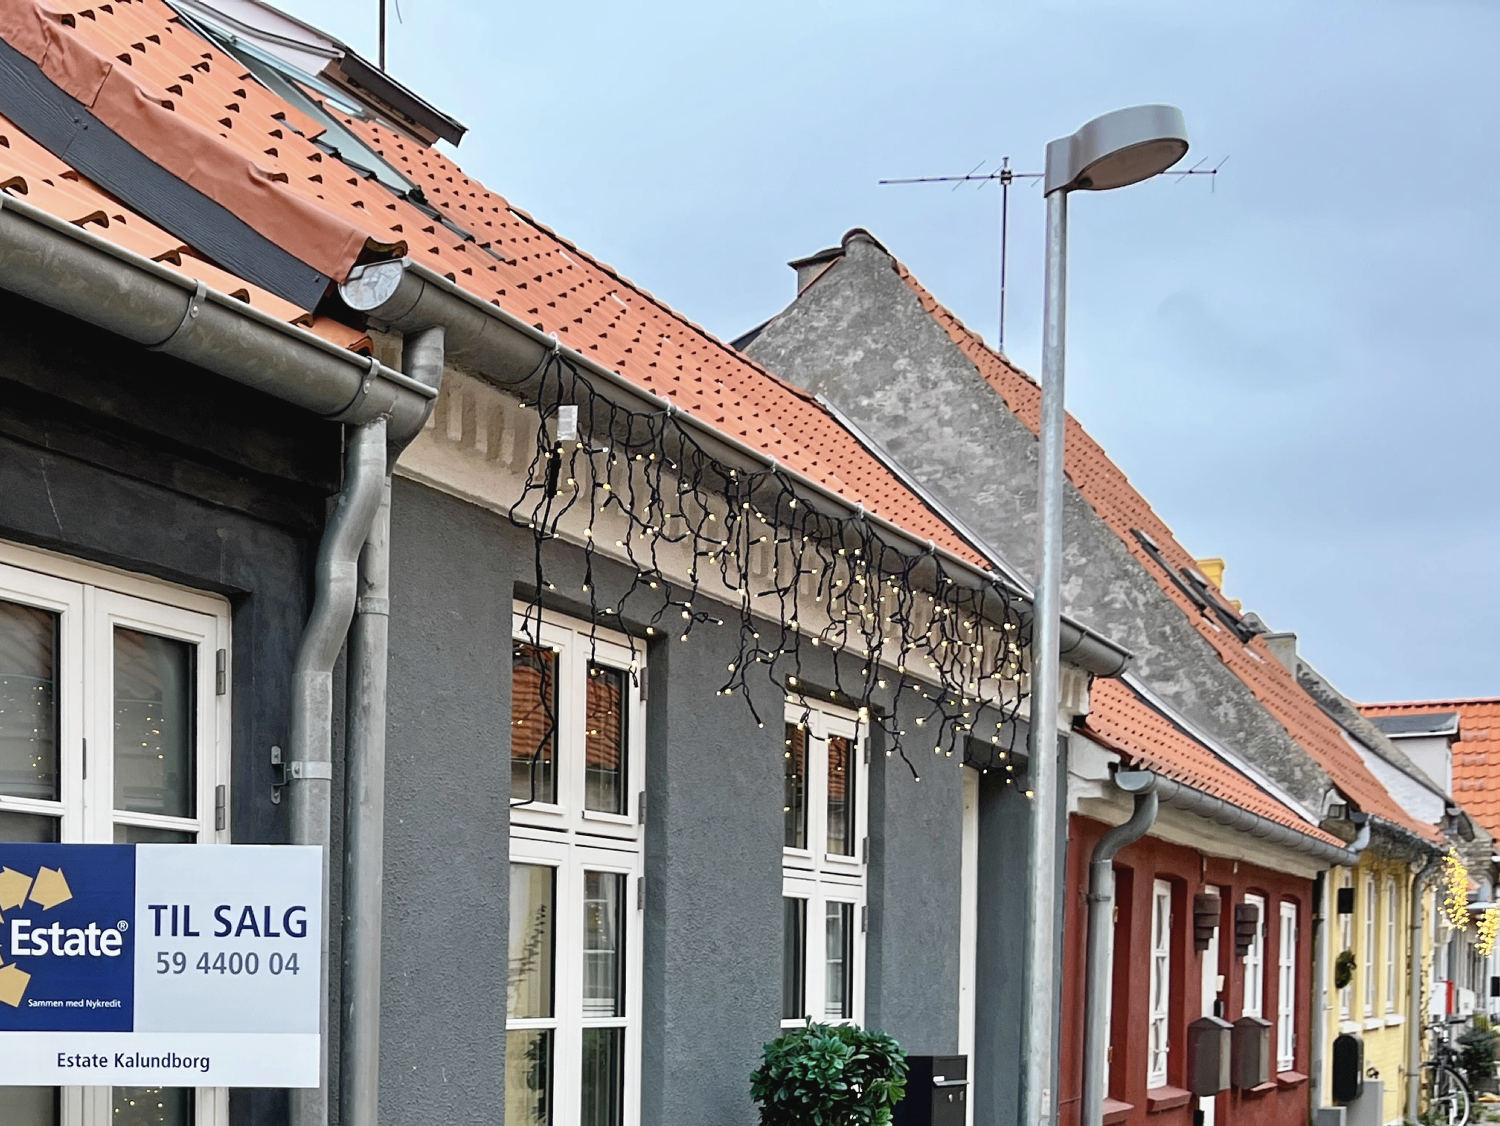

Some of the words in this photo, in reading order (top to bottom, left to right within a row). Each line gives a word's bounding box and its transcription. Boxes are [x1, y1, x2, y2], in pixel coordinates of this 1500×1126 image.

[148, 904, 200, 937] TIL
[214, 905, 308, 938] SALG
[156, 951, 187, 975] 59
[196, 952, 259, 975] 4400
[269, 952, 300, 975] 04
[28, 999, 63, 1007] Sammen
[65, 999, 84, 1007] med
[85, 999, 121, 1009] Nykredit
[57, 1052, 108, 1068] Estate
[114, 1051, 210, 1073] Kalundborg
